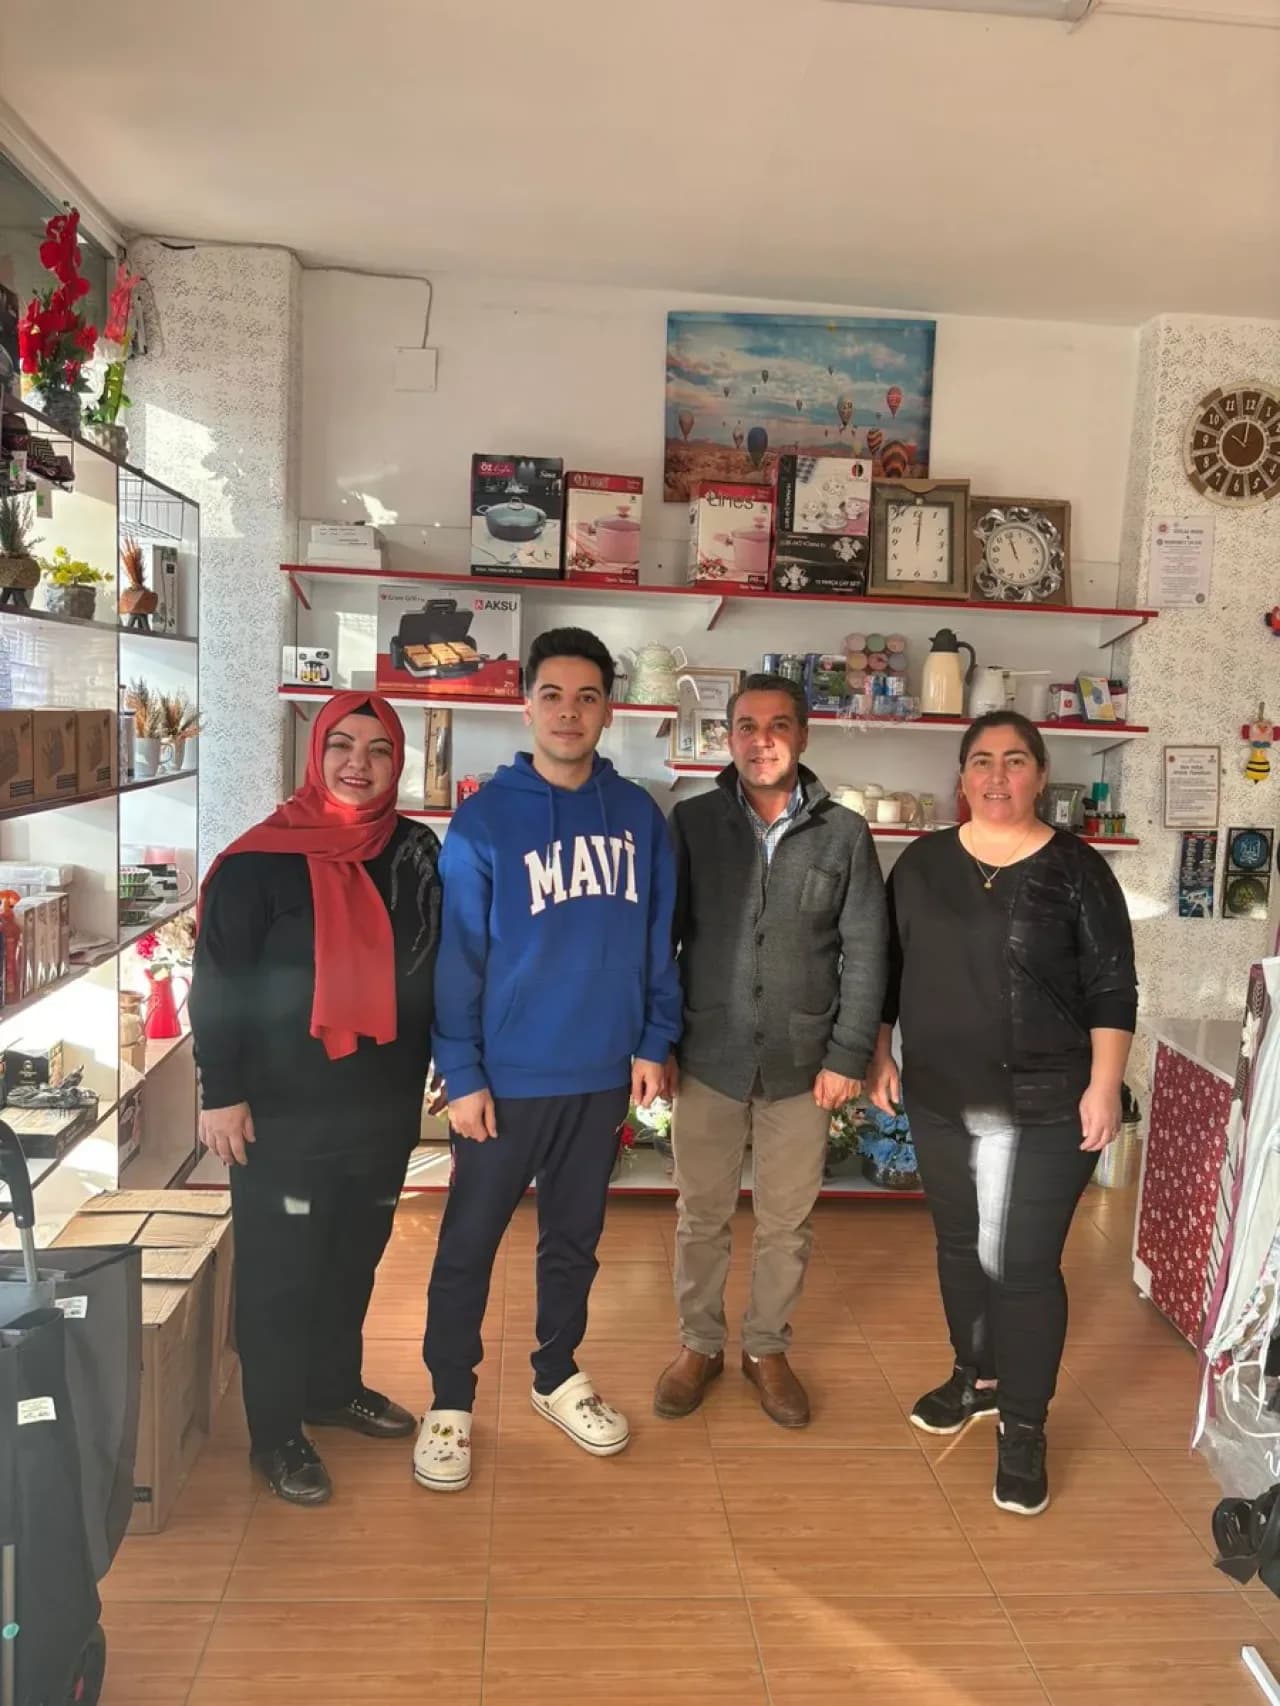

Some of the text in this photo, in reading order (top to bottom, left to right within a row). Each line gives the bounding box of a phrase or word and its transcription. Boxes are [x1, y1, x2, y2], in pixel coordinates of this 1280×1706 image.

[1225, 400, 1235, 411] 11
[1266, 406, 1272, 417] 1
[1209, 413, 1220, 425] 10
[1203, 434, 1209, 446] 9
[1203, 456, 1210, 468] 8
[1215, 473, 1221, 485] 7
[1252, 477, 1261, 489] 5
[1233, 479, 1240, 492] 6
[484, 600, 517, 611] AKSU
[524, 829, 638, 916] MAVİ
